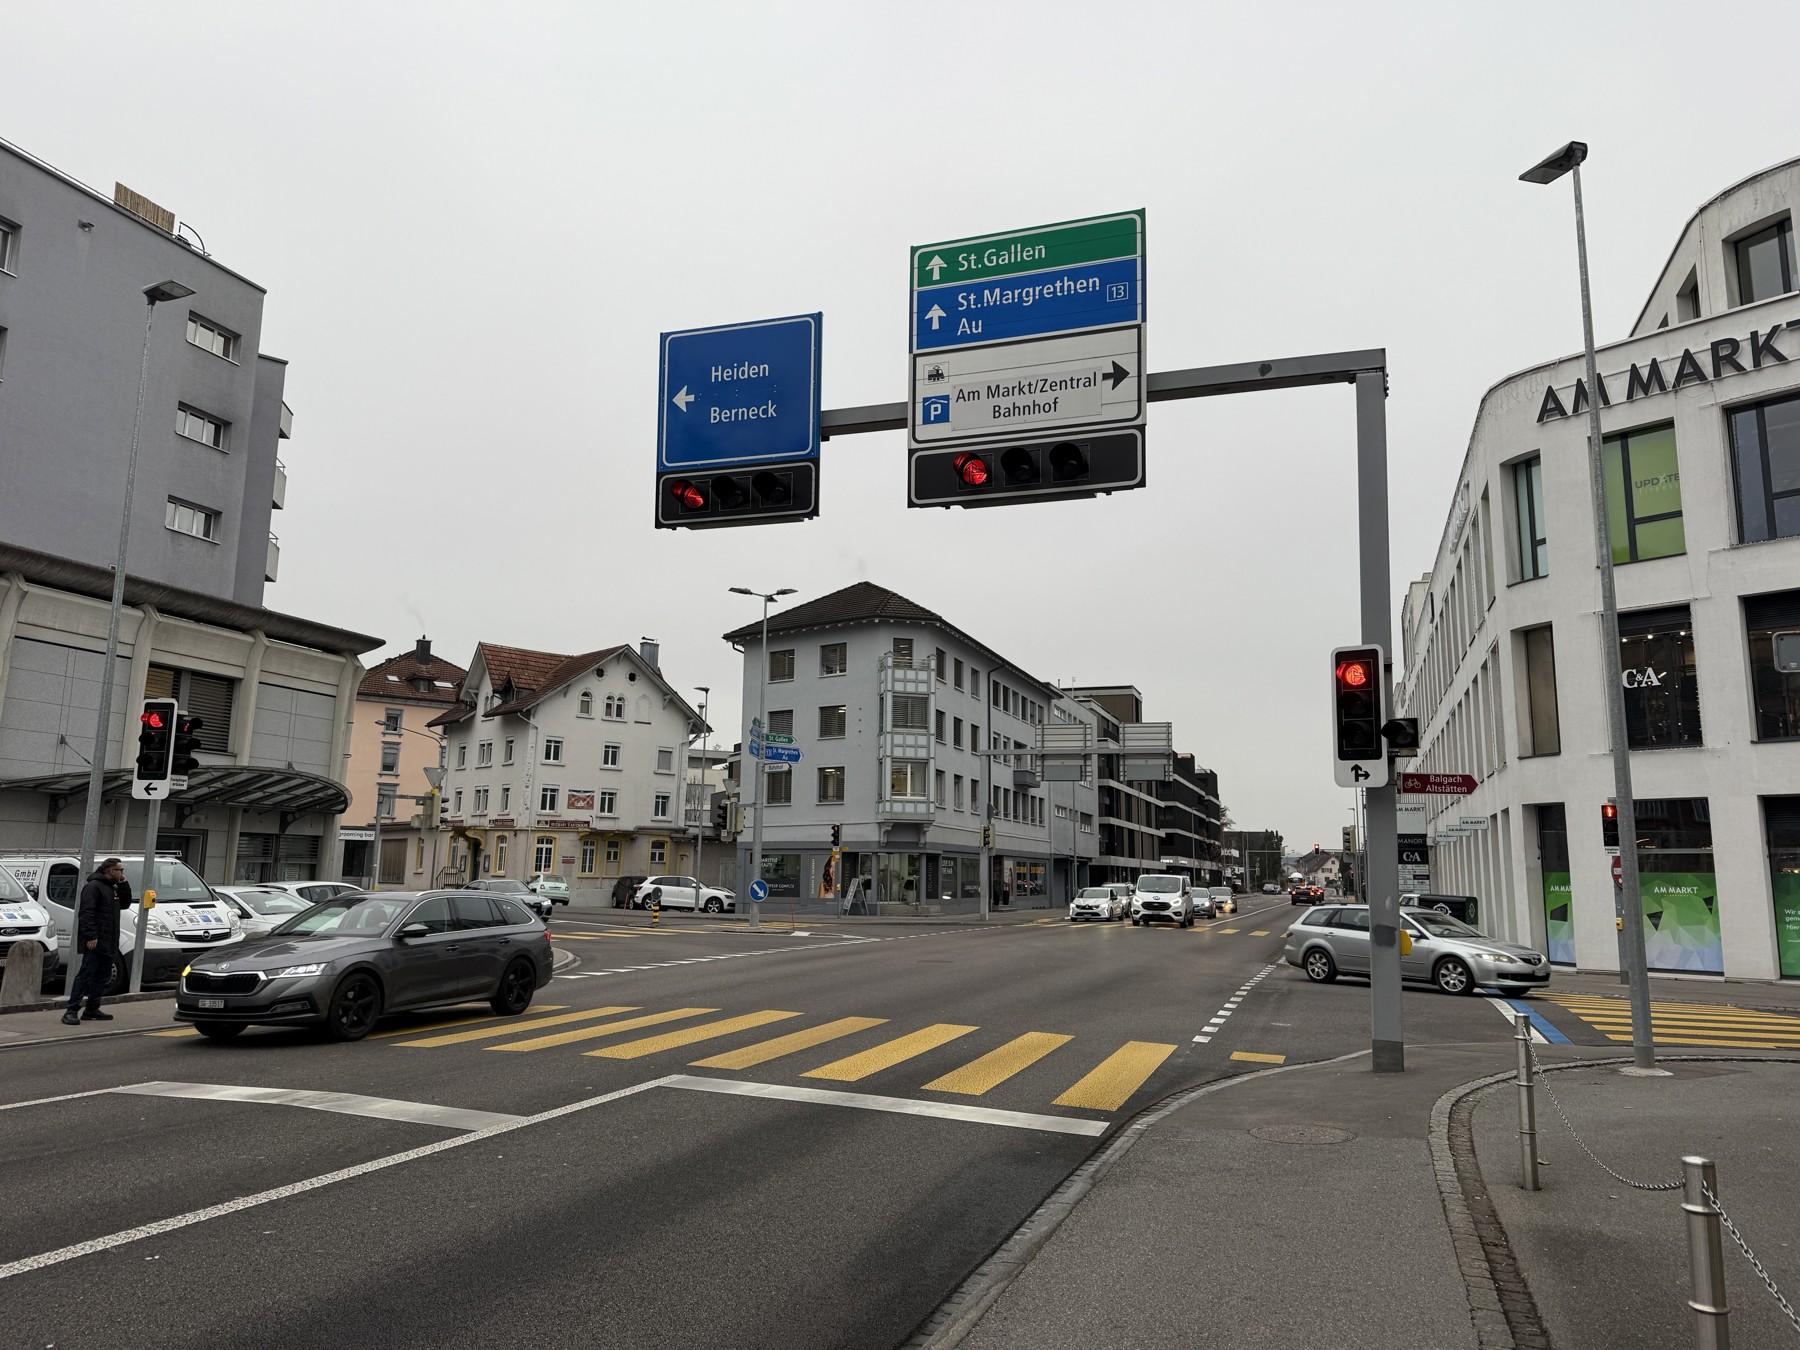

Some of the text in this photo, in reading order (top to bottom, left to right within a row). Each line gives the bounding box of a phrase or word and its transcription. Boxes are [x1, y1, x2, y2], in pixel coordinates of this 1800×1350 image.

[958, 243, 1046, 271] St.Gallen
[957, 276, 1125, 311] St.Margrethen 13
[957, 317, 983, 336] Au
[711, 361, 769, 383] Heiden
[955, 371, 1098, 403] Am Markt/Zentral
[992, 397, 1059, 419] Bahnhof
[1536, 373, 1611, 423] AM
[710, 399, 777, 424] Berneck
[930, 403, 942, 421] P
[1635, 473, 1680, 489] UPDATE
[1622, 667, 1661, 688] C&A
[1425, 785, 1467, 793] Altstätten
[1429, 774, 1463, 785] Balgach
[14, 869, 38, 878] GmbH
[1669, 886, 1698, 894] MARKT
